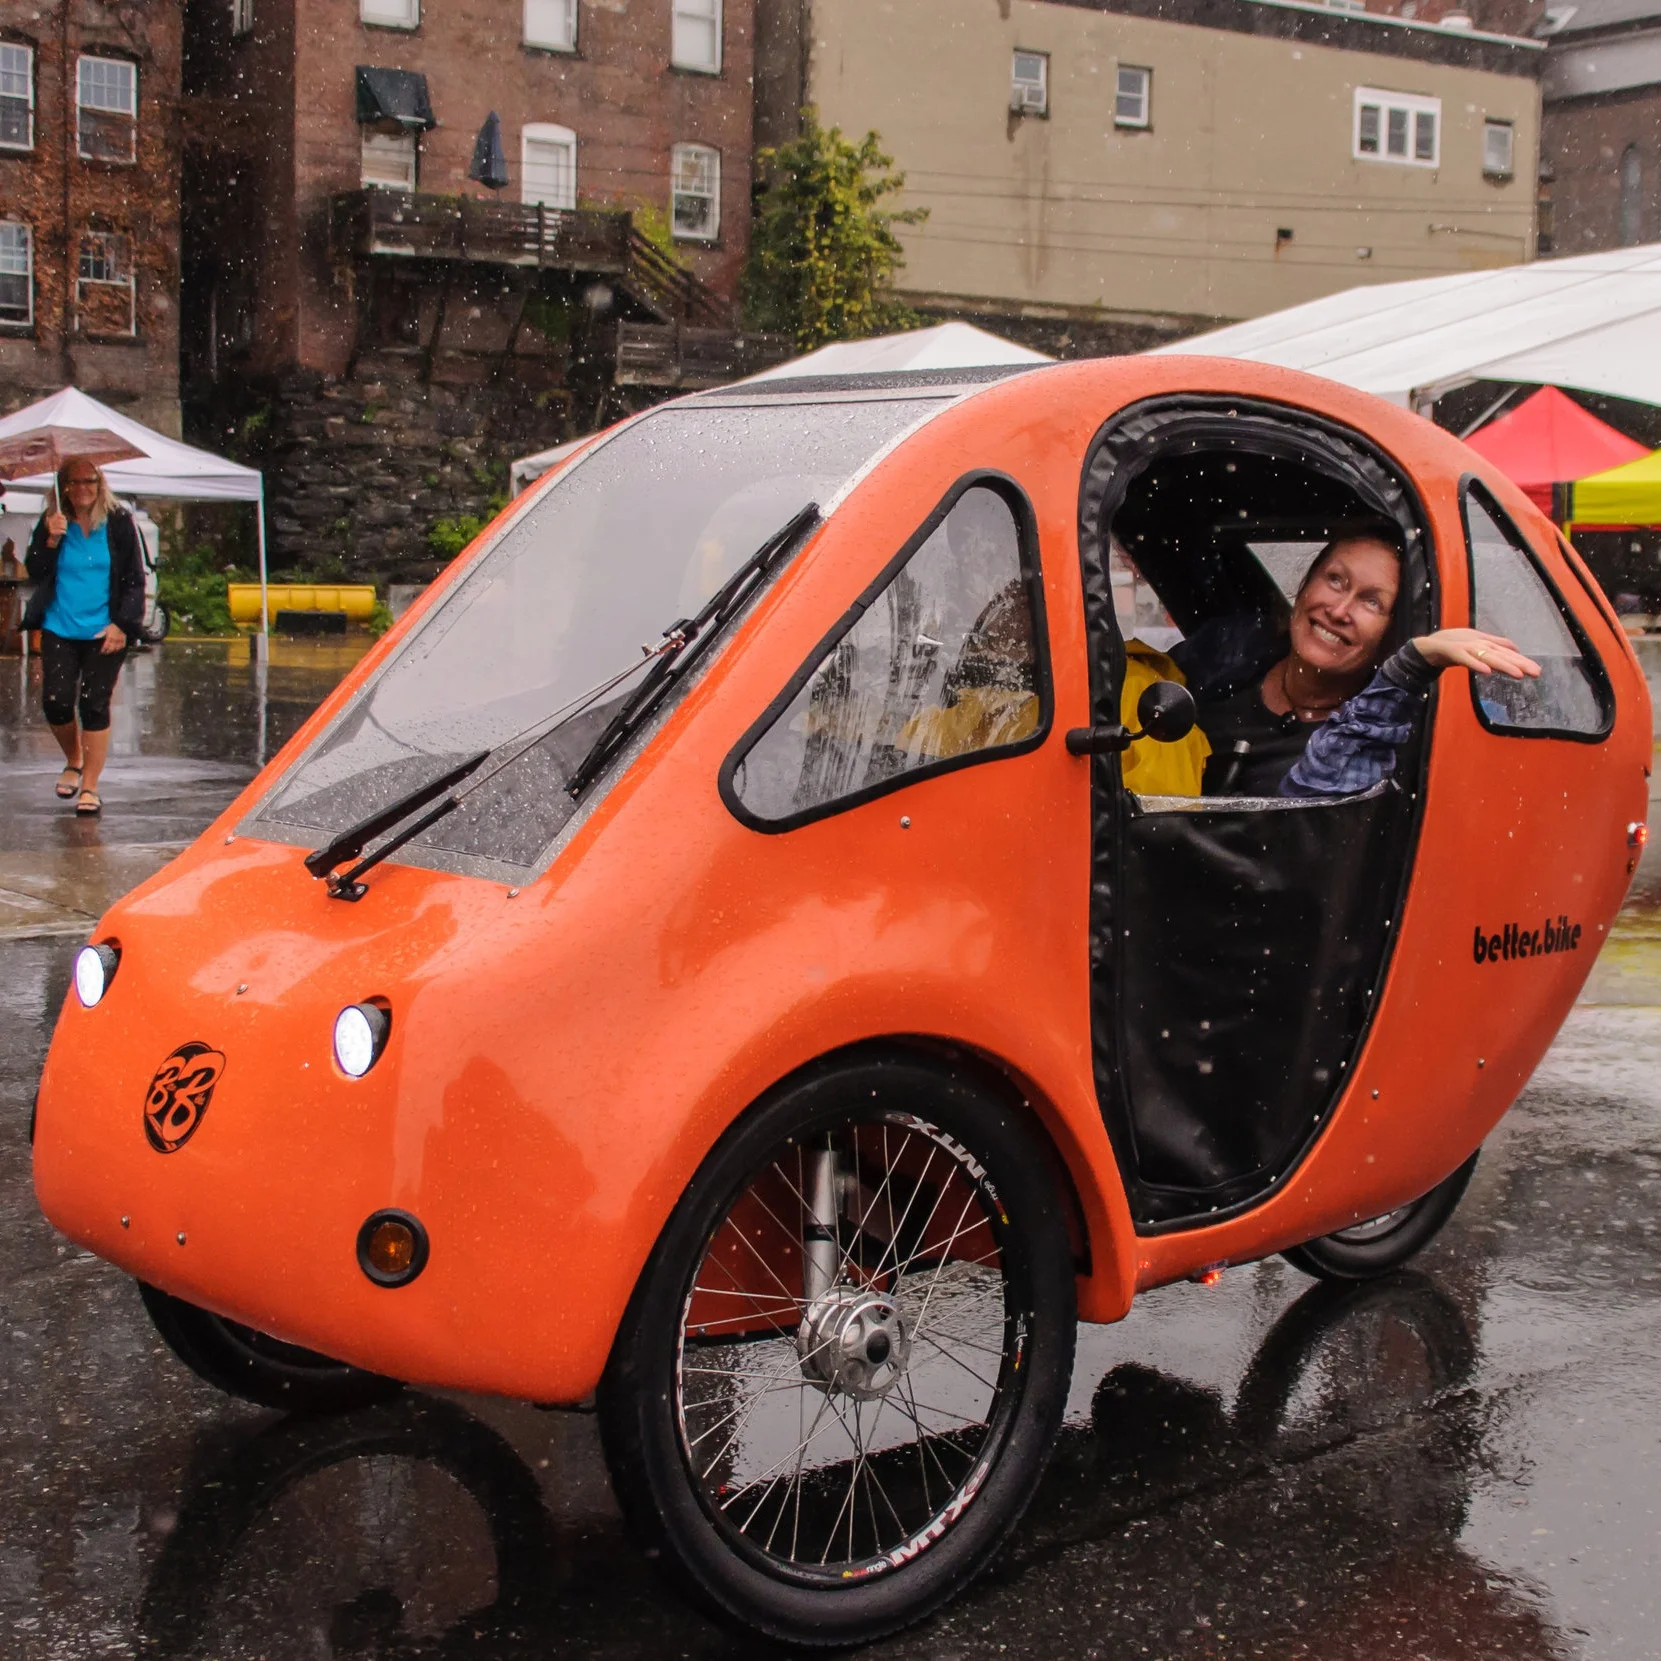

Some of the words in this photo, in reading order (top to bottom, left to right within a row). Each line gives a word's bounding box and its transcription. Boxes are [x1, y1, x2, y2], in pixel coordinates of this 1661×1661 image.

[1473, 914, 1582, 965] better.bike
[906, 1115, 988, 1179] MTX
[889, 1485, 976, 1567] MTX
